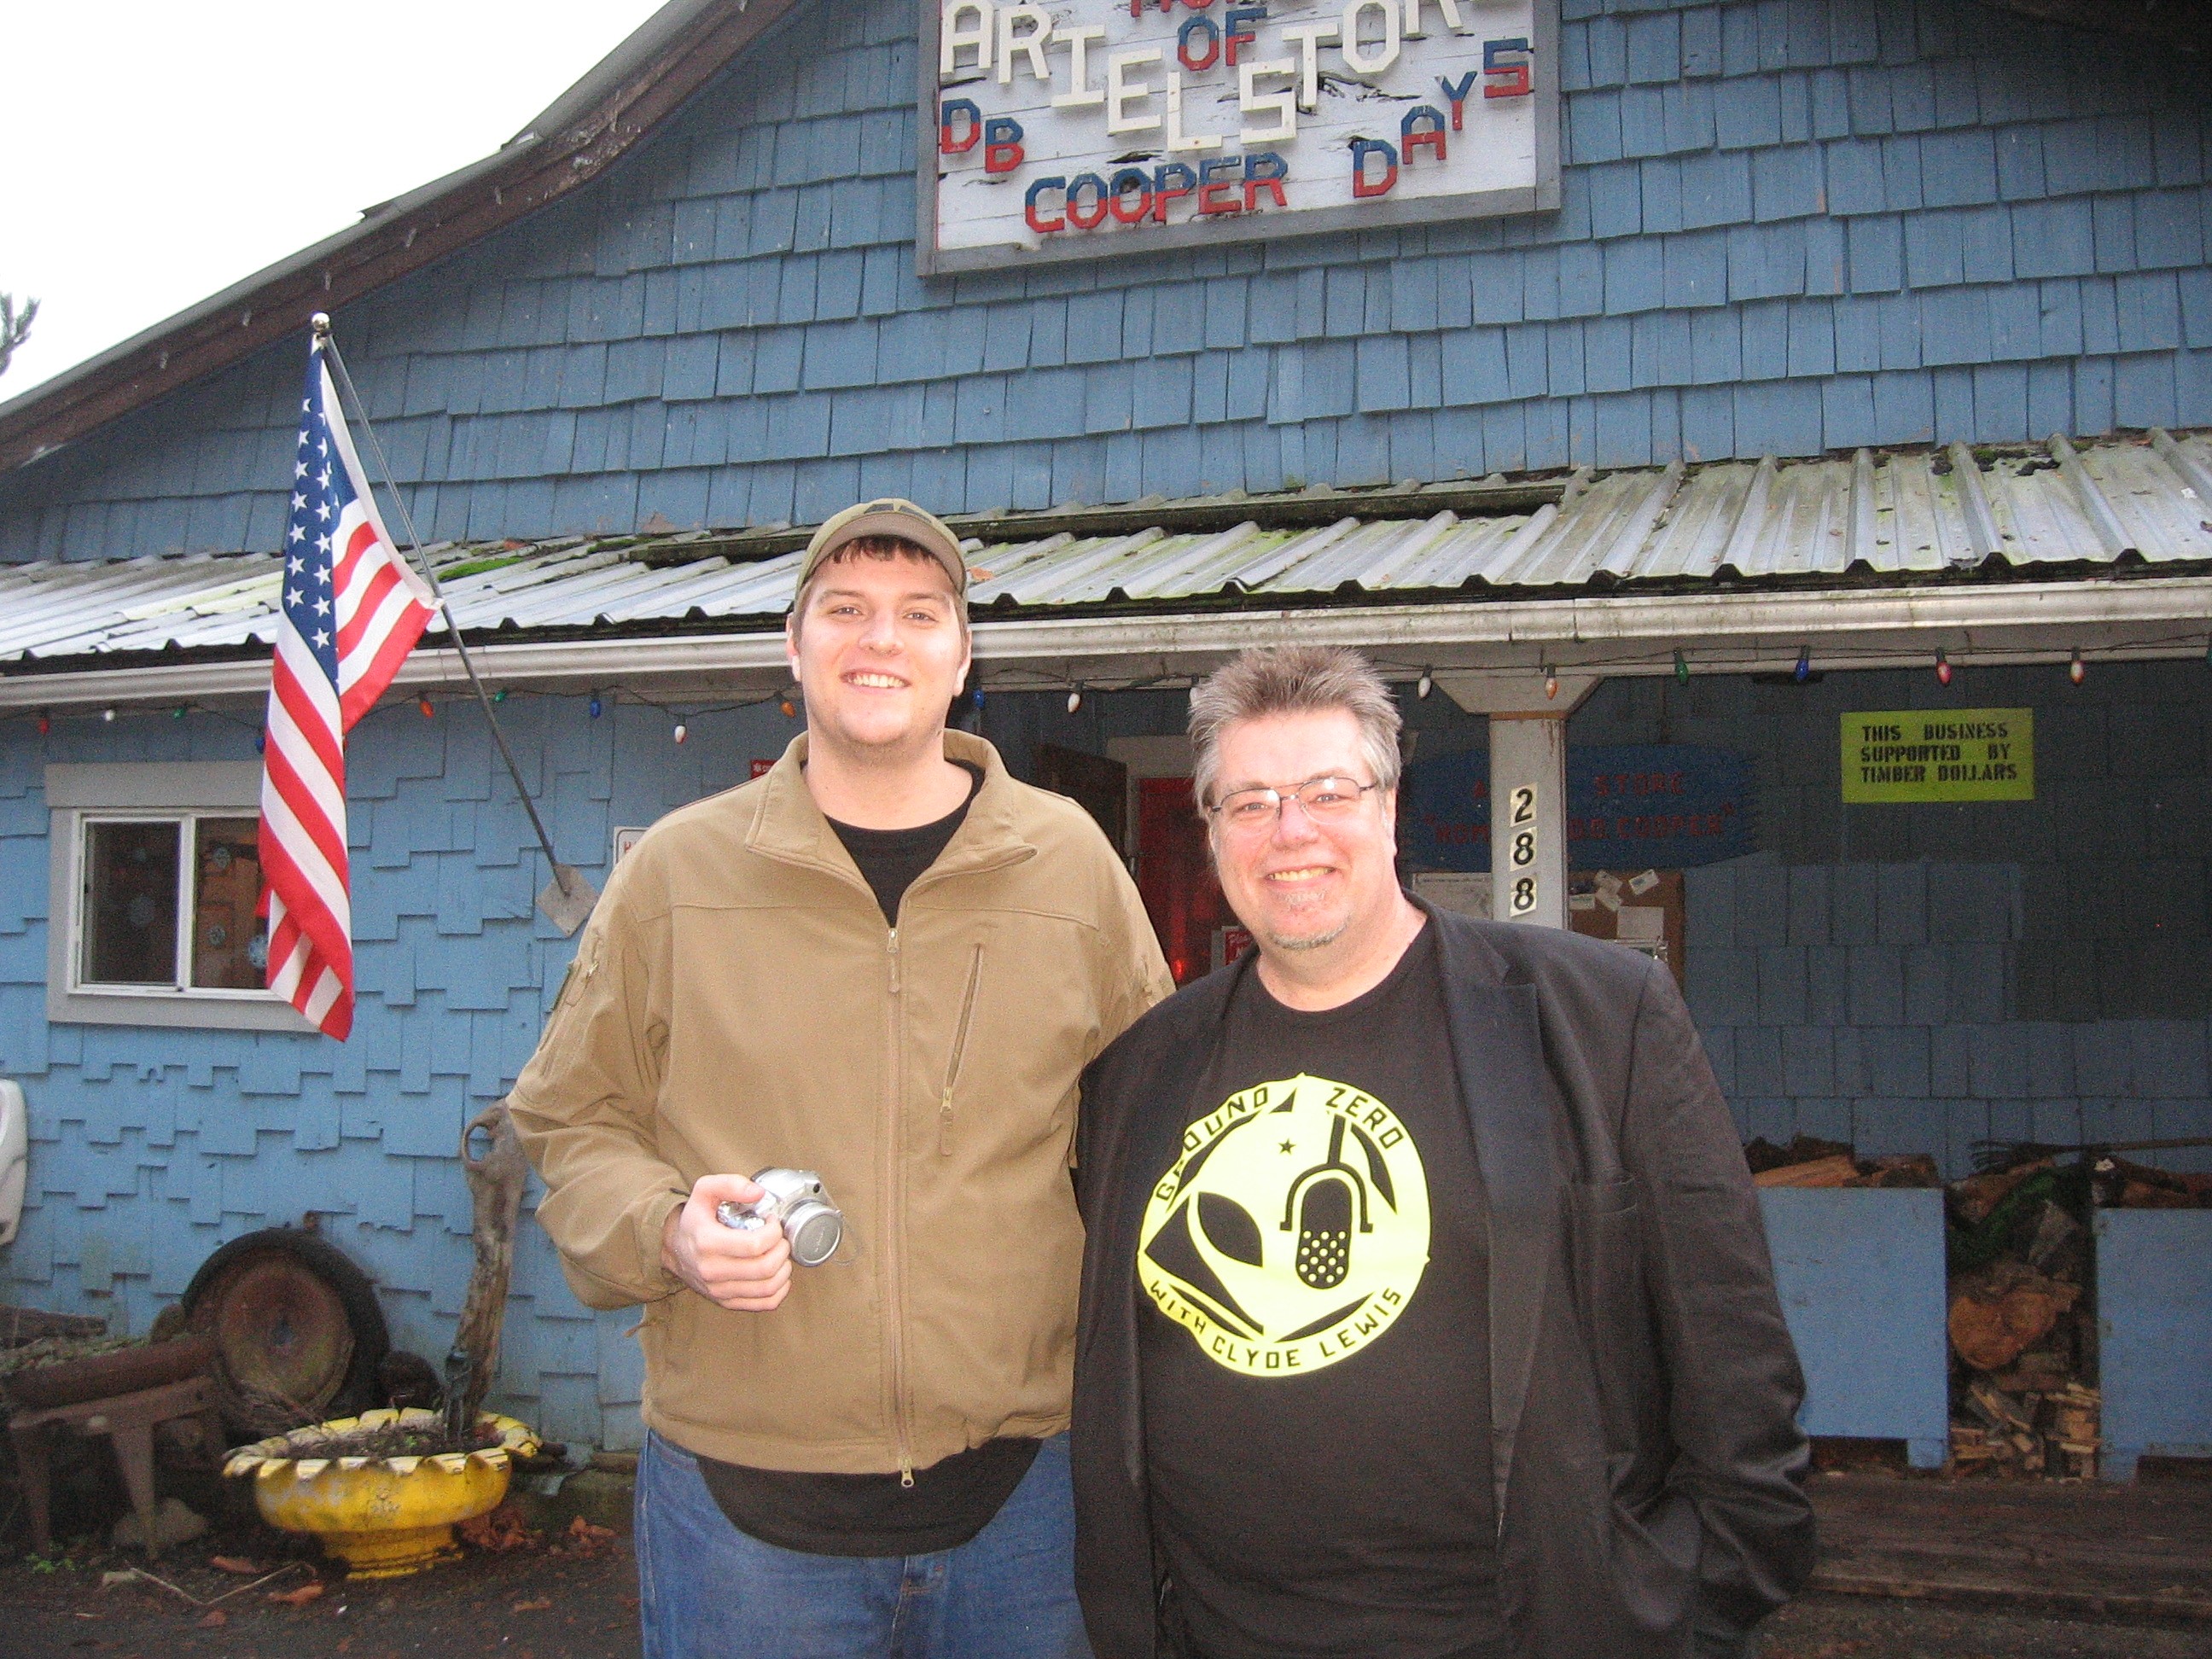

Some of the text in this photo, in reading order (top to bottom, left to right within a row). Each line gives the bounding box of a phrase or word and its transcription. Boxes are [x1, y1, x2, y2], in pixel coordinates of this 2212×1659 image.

[1178, 8, 1267, 71] OF
[940, 0, 1222, 152] ARIEL
[940, 38, 1530, 233] DB COOPER DAYS
[1861, 743, 2011, 762] SUPPORTED BY
[1862, 723, 2007, 742] THIS BUSINESS
[1594, 772, 1685, 797] STORE
[1862, 764, 2017, 783] TIMBER DOLLARS
[1326, 1087, 1404, 1150] ZERO
[1150, 1280, 1401, 1369] WITH CLYDE LEWIS
